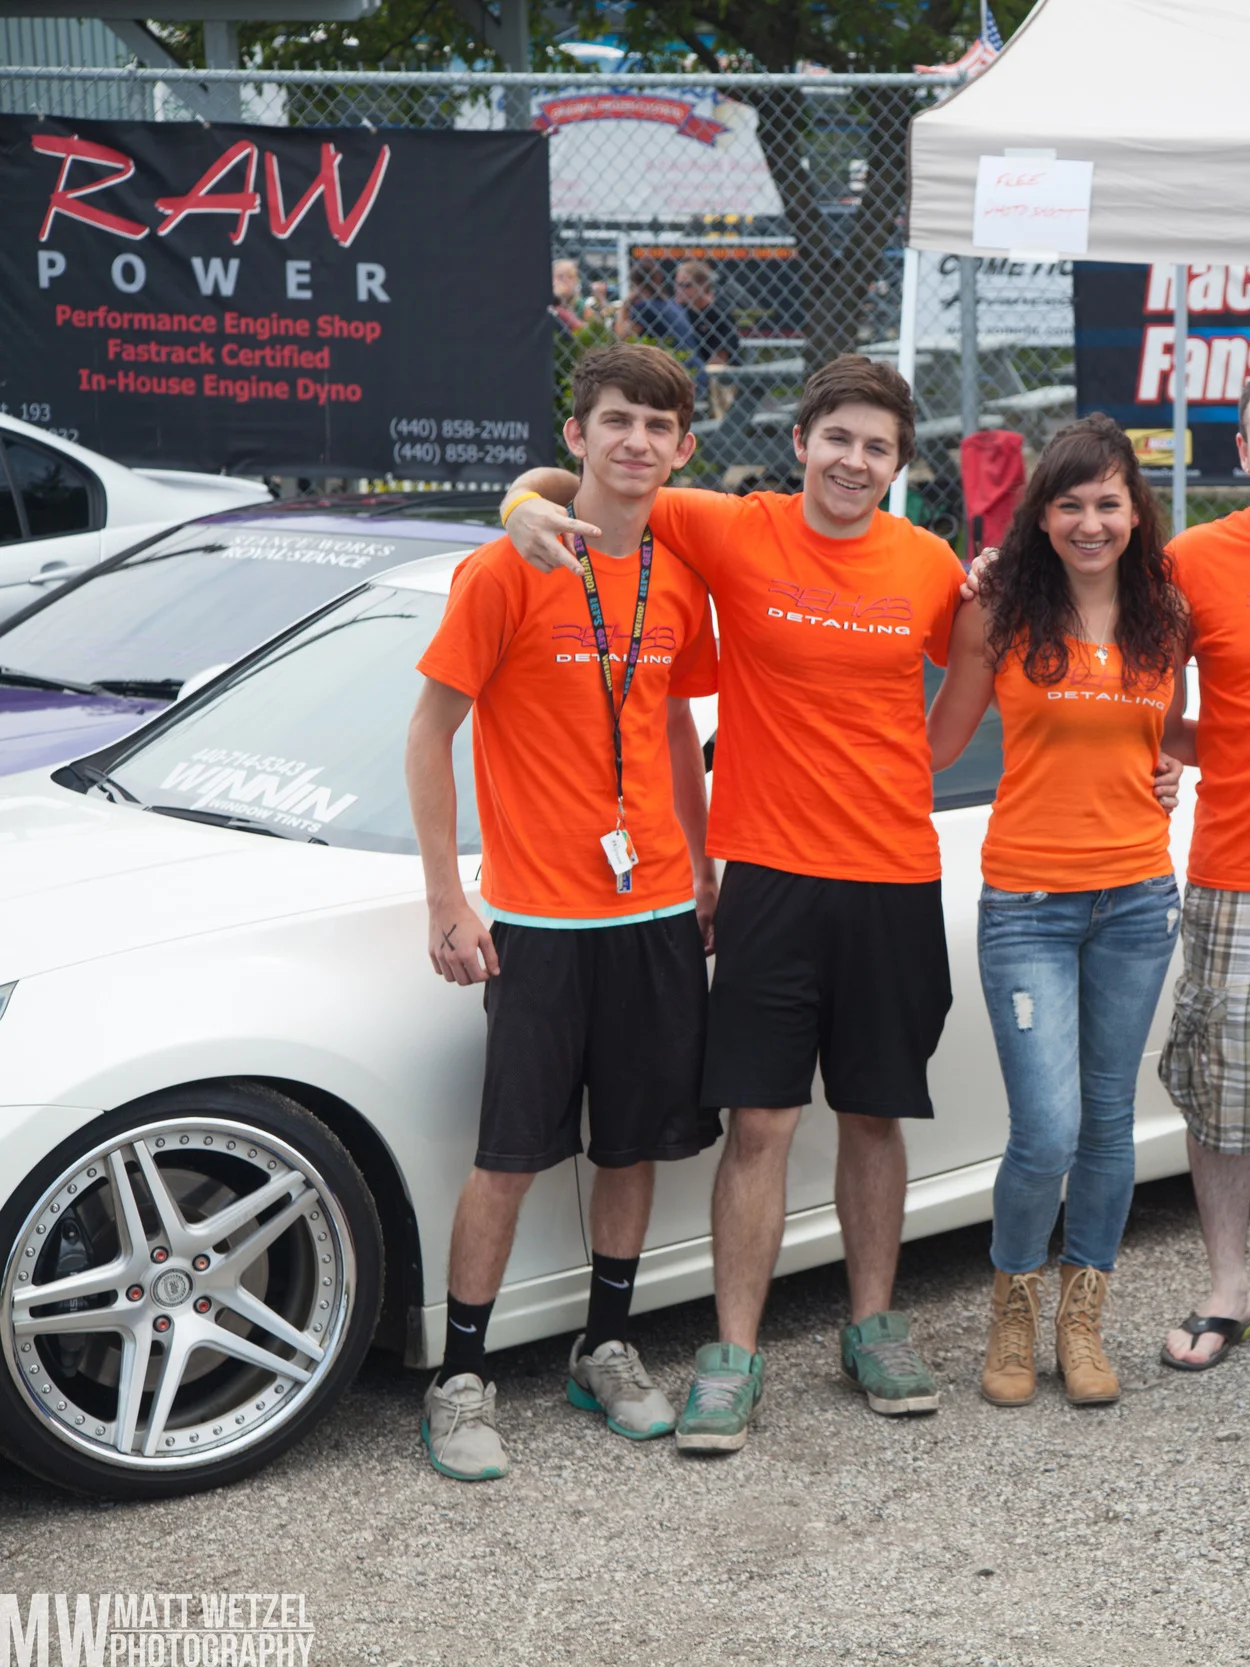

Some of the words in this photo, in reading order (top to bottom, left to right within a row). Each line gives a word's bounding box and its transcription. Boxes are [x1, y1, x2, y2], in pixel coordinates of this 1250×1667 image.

[32, 134, 391, 248] RAW
[994, 171, 1048, 190] FREE
[37, 249, 391, 303] POWER
[55, 304, 217, 330] Performance
[224, 311, 311, 340] Engine
[317, 315, 382, 343] Shop
[107, 338, 215, 365] Fastrack
[221, 343, 330, 369] Certified
[78, 368, 196, 395] In-House
[203, 375, 290, 402] Engine
[296, 380, 362, 405] Dyno
[20, 402, 51, 422] 193
[389, 417, 438, 441] (440)
[441, 419, 529, 440] 858-2WIN
[393, 441, 441, 466] (440)
[445, 443, 528, 465] 858-2946
[642, 545, 652, 567] GET
[580, 556, 597, 594] WEIRD!
[639, 568, 650, 597] LET'S
[768, 578, 914, 621] REHAB
[633, 601, 645, 638] WEIRD!
[767, 607, 911, 635] DETAILING
[1047, 690, 1165, 710] DETAILING
[159, 762, 360, 824] WINNIN
[208, 797, 274, 821] WINDOW
[273, 812, 322, 833] TINTS
